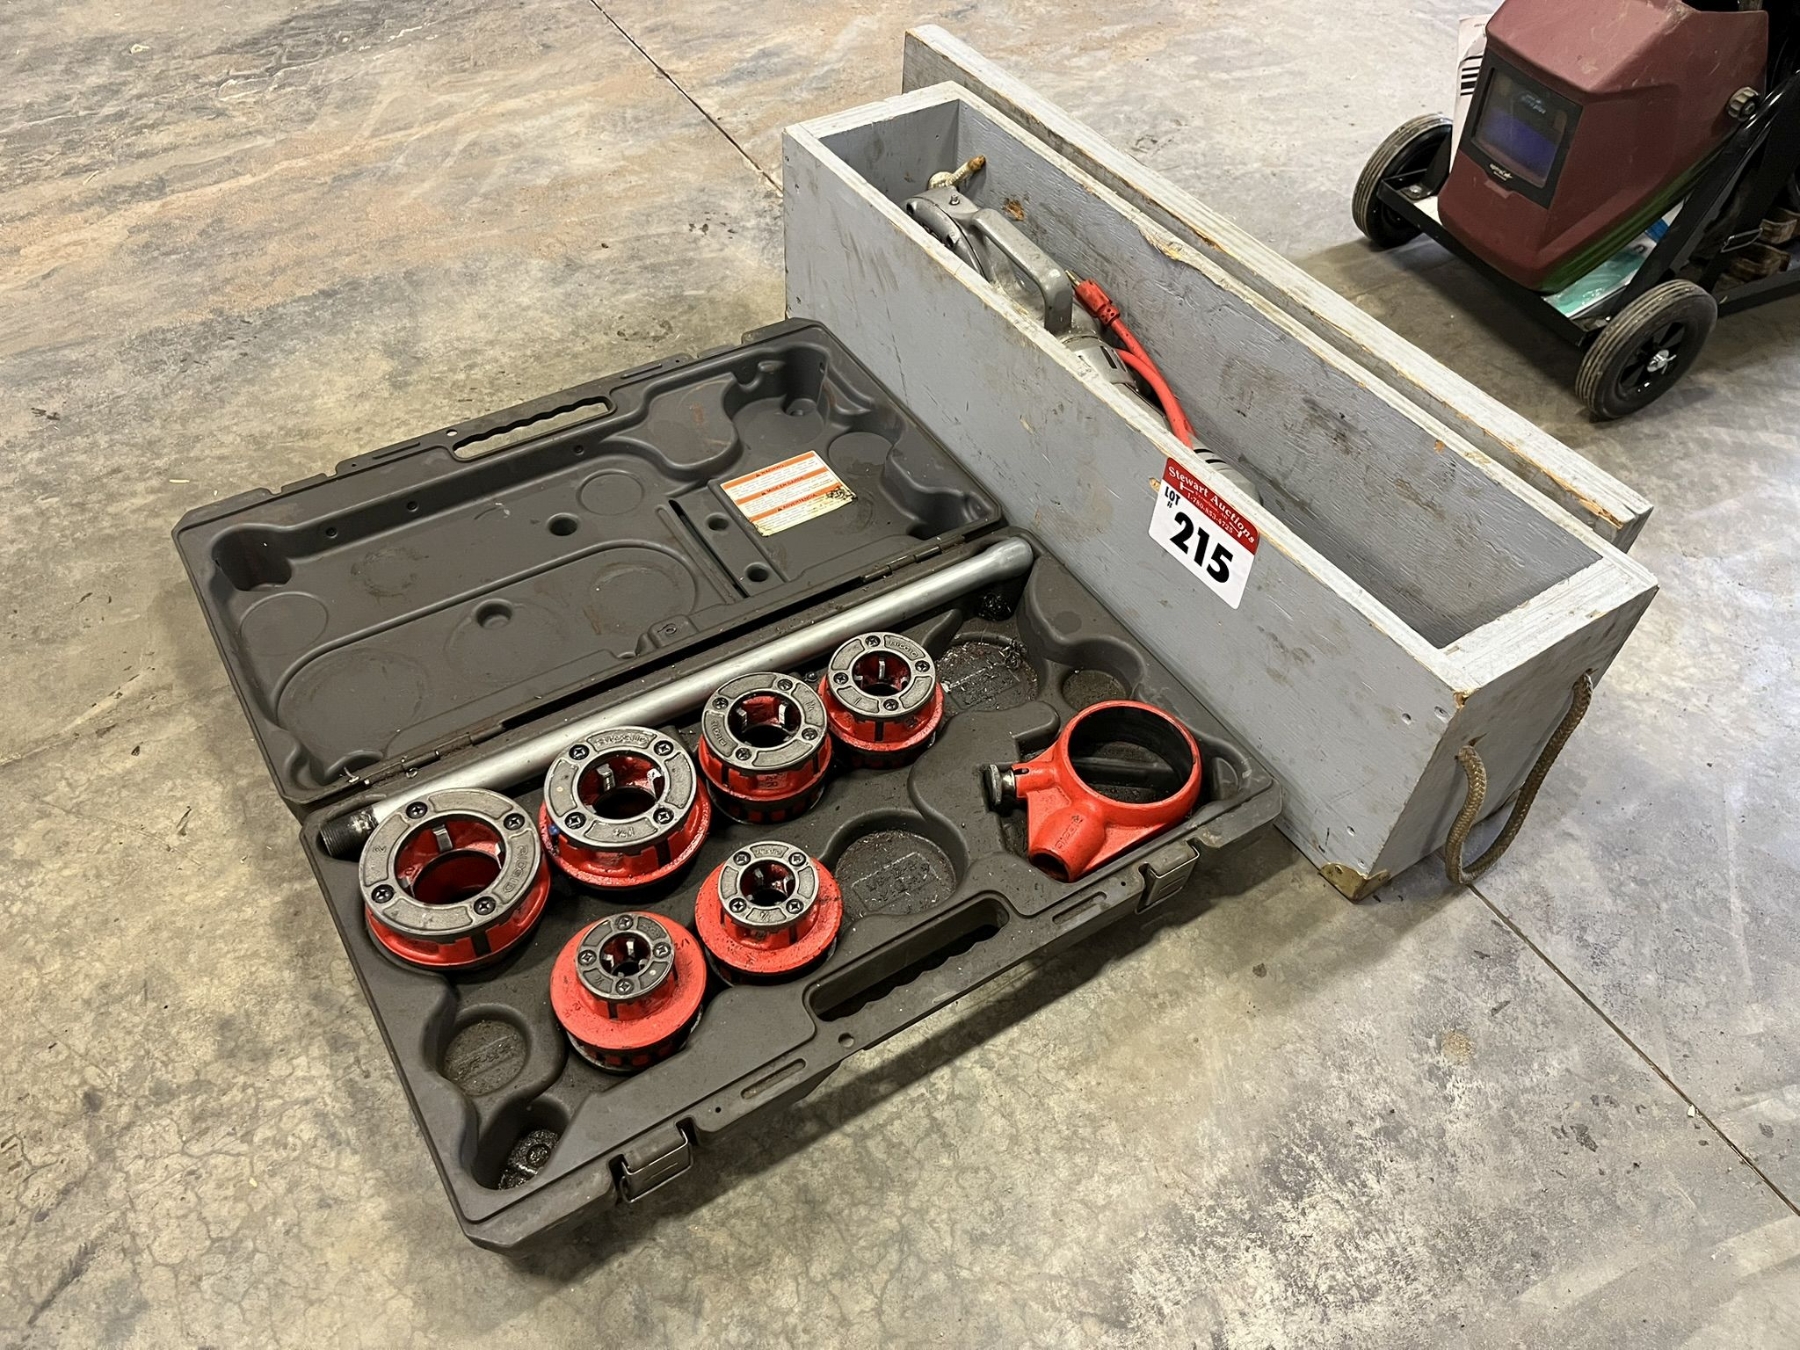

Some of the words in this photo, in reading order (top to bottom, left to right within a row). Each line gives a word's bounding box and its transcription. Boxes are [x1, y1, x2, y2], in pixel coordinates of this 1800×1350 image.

[1164, 486, 1181, 506] LOT
[1168, 465, 1209, 497] Stewart
[1210, 495, 1255, 544] Auctions
[1169, 511, 1234, 584] 215
